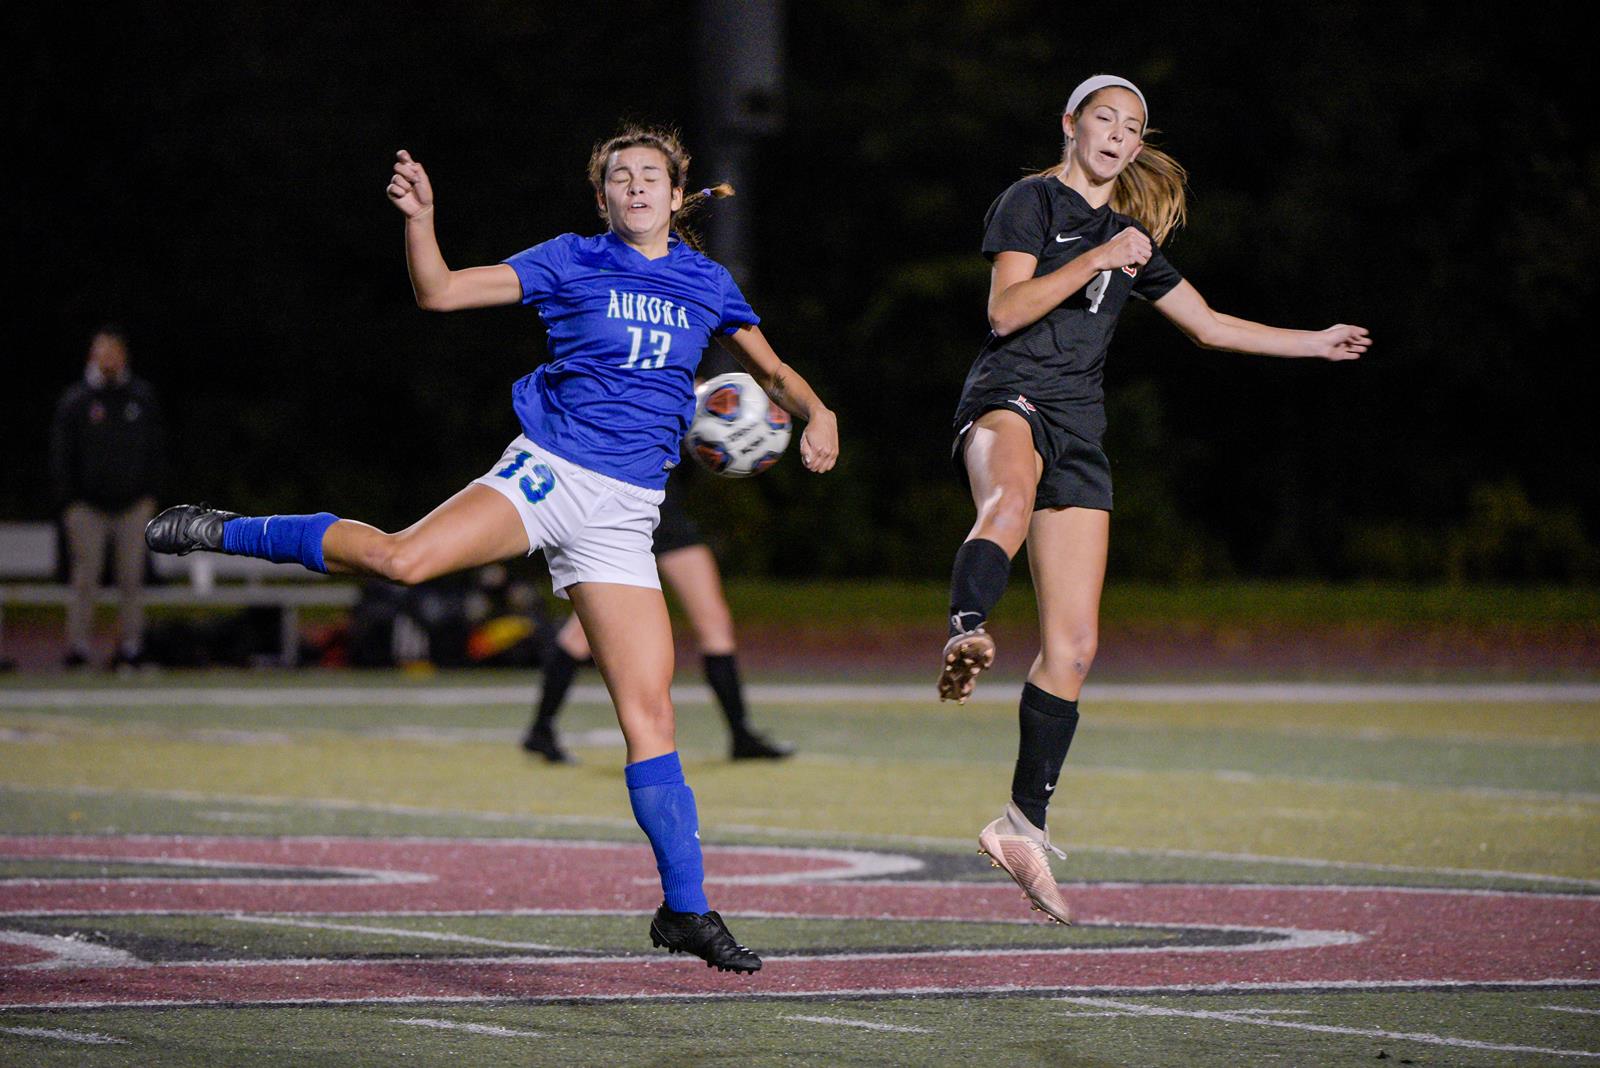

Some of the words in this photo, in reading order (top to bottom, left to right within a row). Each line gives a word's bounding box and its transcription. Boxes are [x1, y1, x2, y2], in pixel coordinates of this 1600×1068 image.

[607, 289, 690, 329] AURORA
[619, 325, 672, 369] 13
[494, 450, 556, 504] 13
